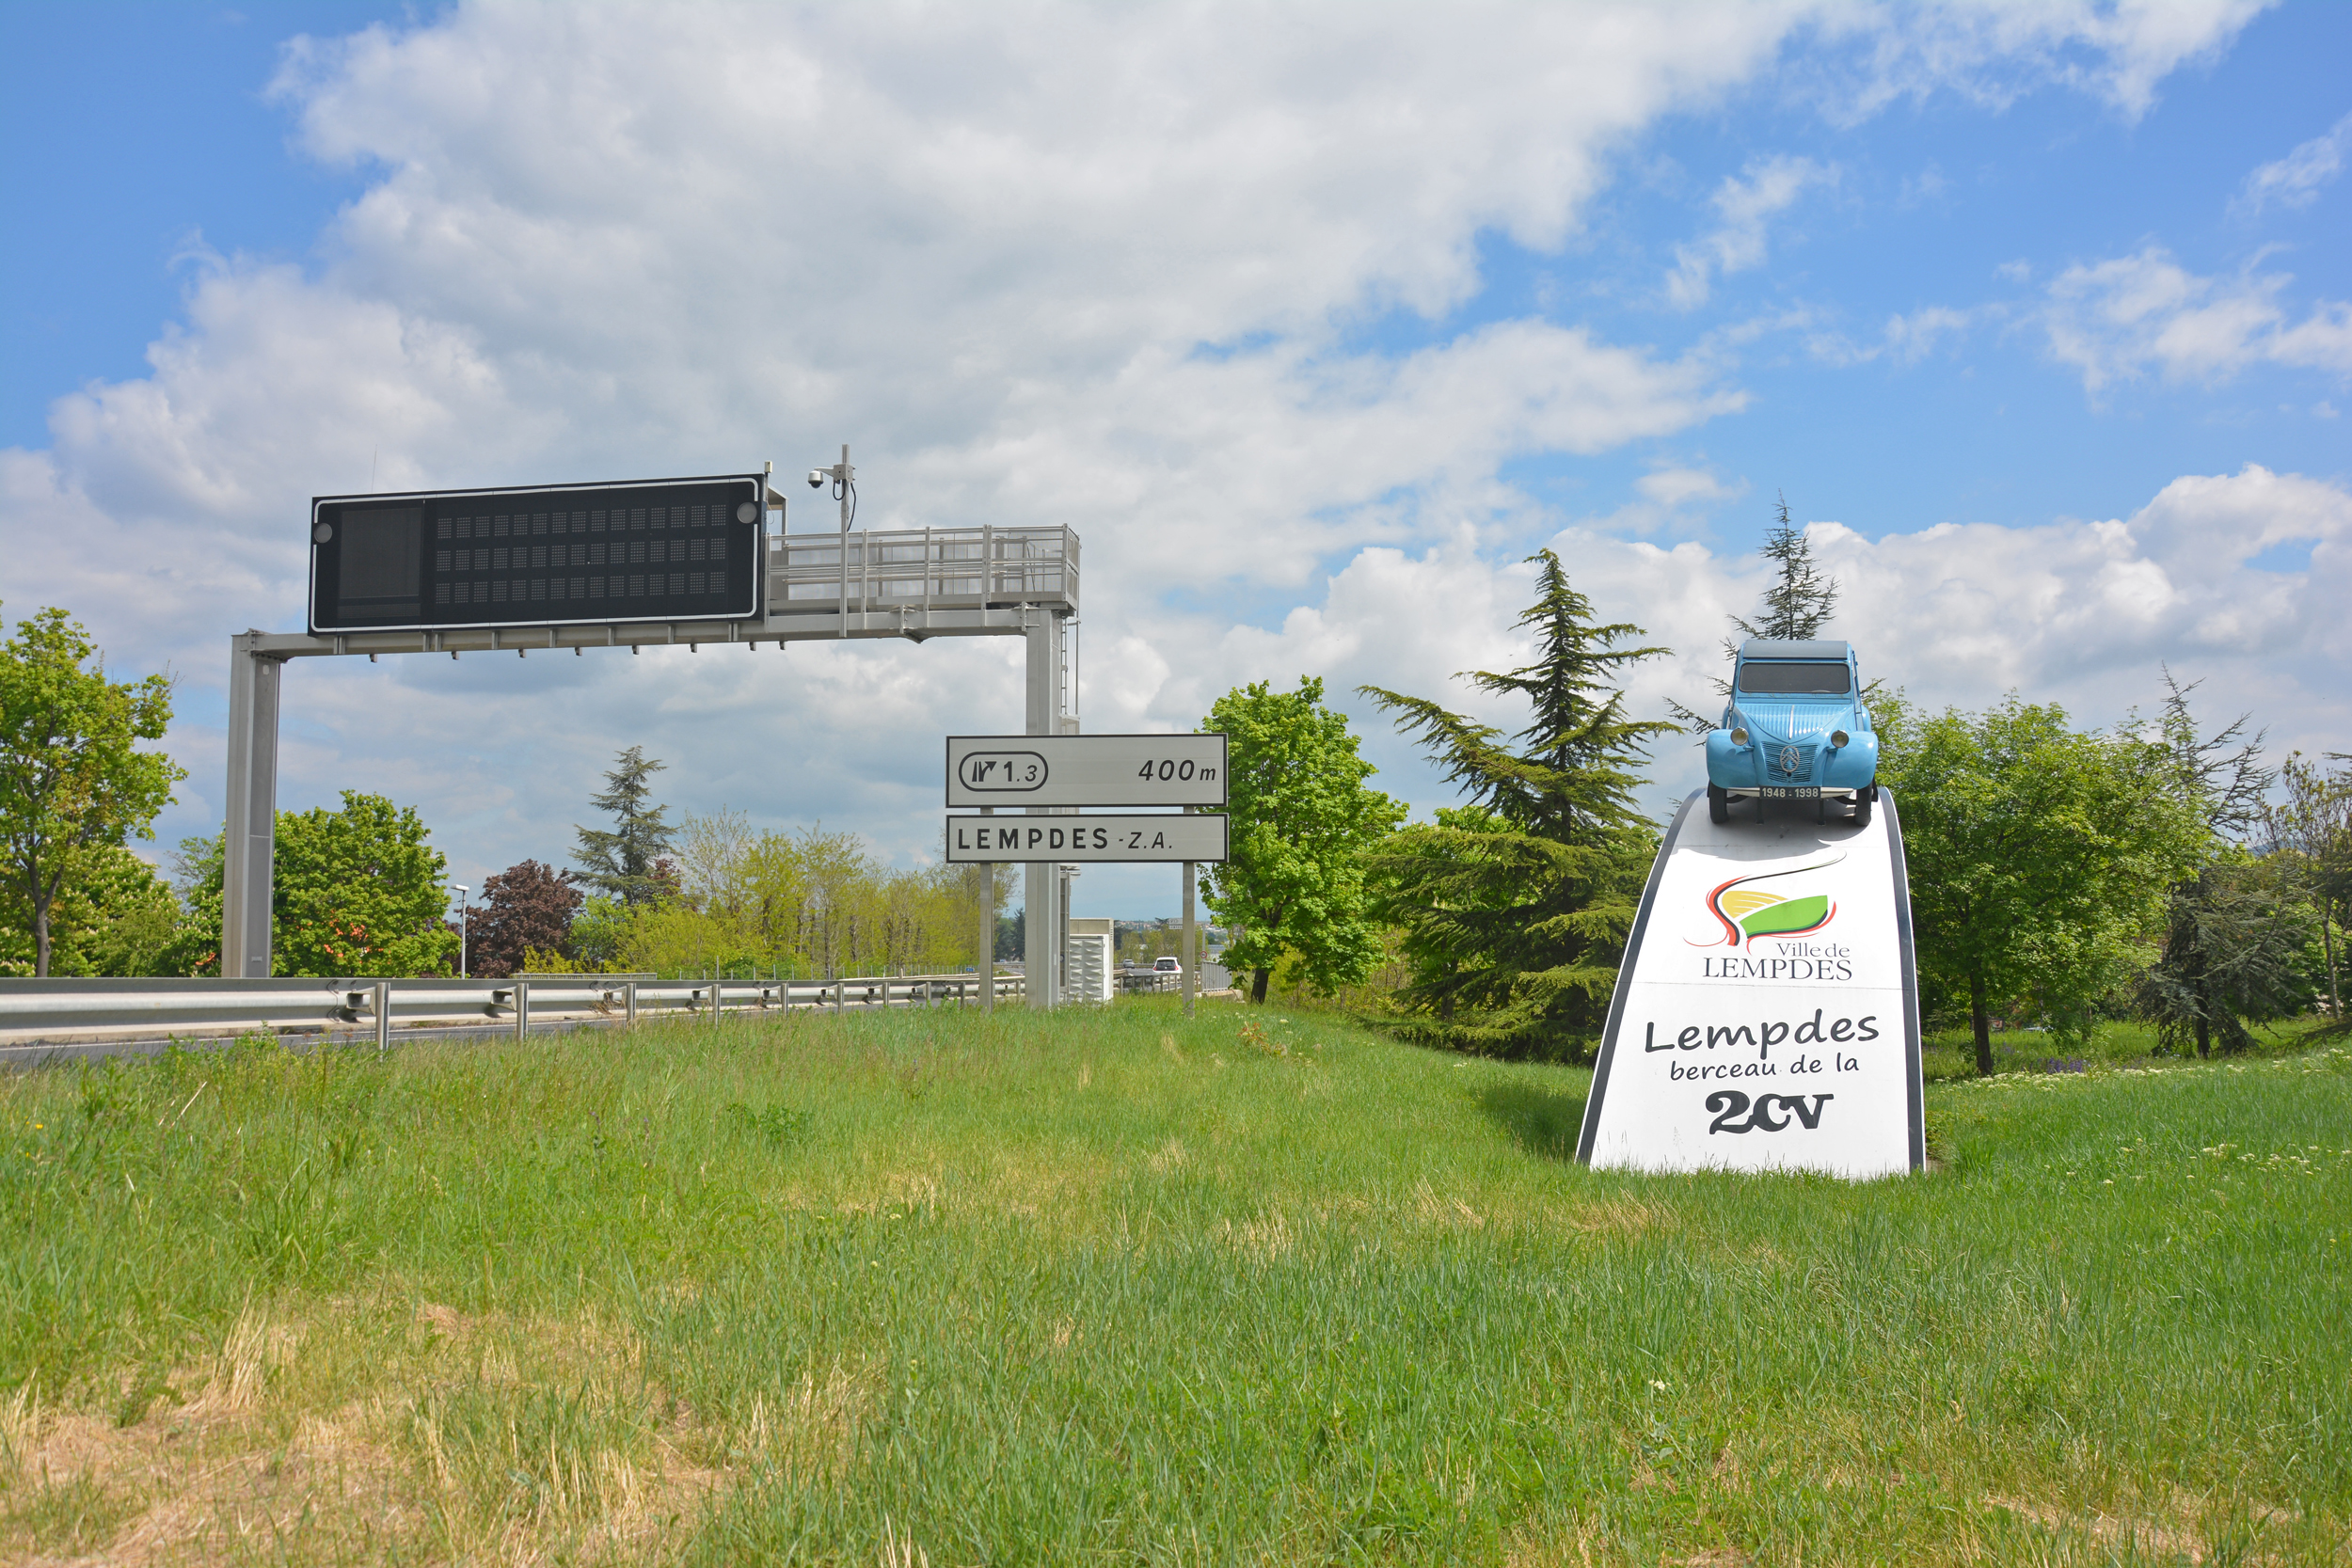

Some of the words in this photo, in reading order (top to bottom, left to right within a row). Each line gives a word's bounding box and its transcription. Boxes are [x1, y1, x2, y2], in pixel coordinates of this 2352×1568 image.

[1003, 760, 1038, 783] 1.3
[1762, 787, 1786, 799] 1948
[1794, 787, 1819, 799] 1998
[958, 828, 1108, 849] LEMPDES
[1776, 942, 1821, 958] Ville
[1824, 942, 1851, 958] de
[1702, 957, 1852, 981] LEMPDES
[1645, 1008, 1880, 1060] Lempdes
[1670, 1061, 1777, 1081] berceau
[1789, 1054, 1823, 1074] de
[1836, 1053, 1860, 1072] la
[1705, 1090, 1835, 1135] 2CV
